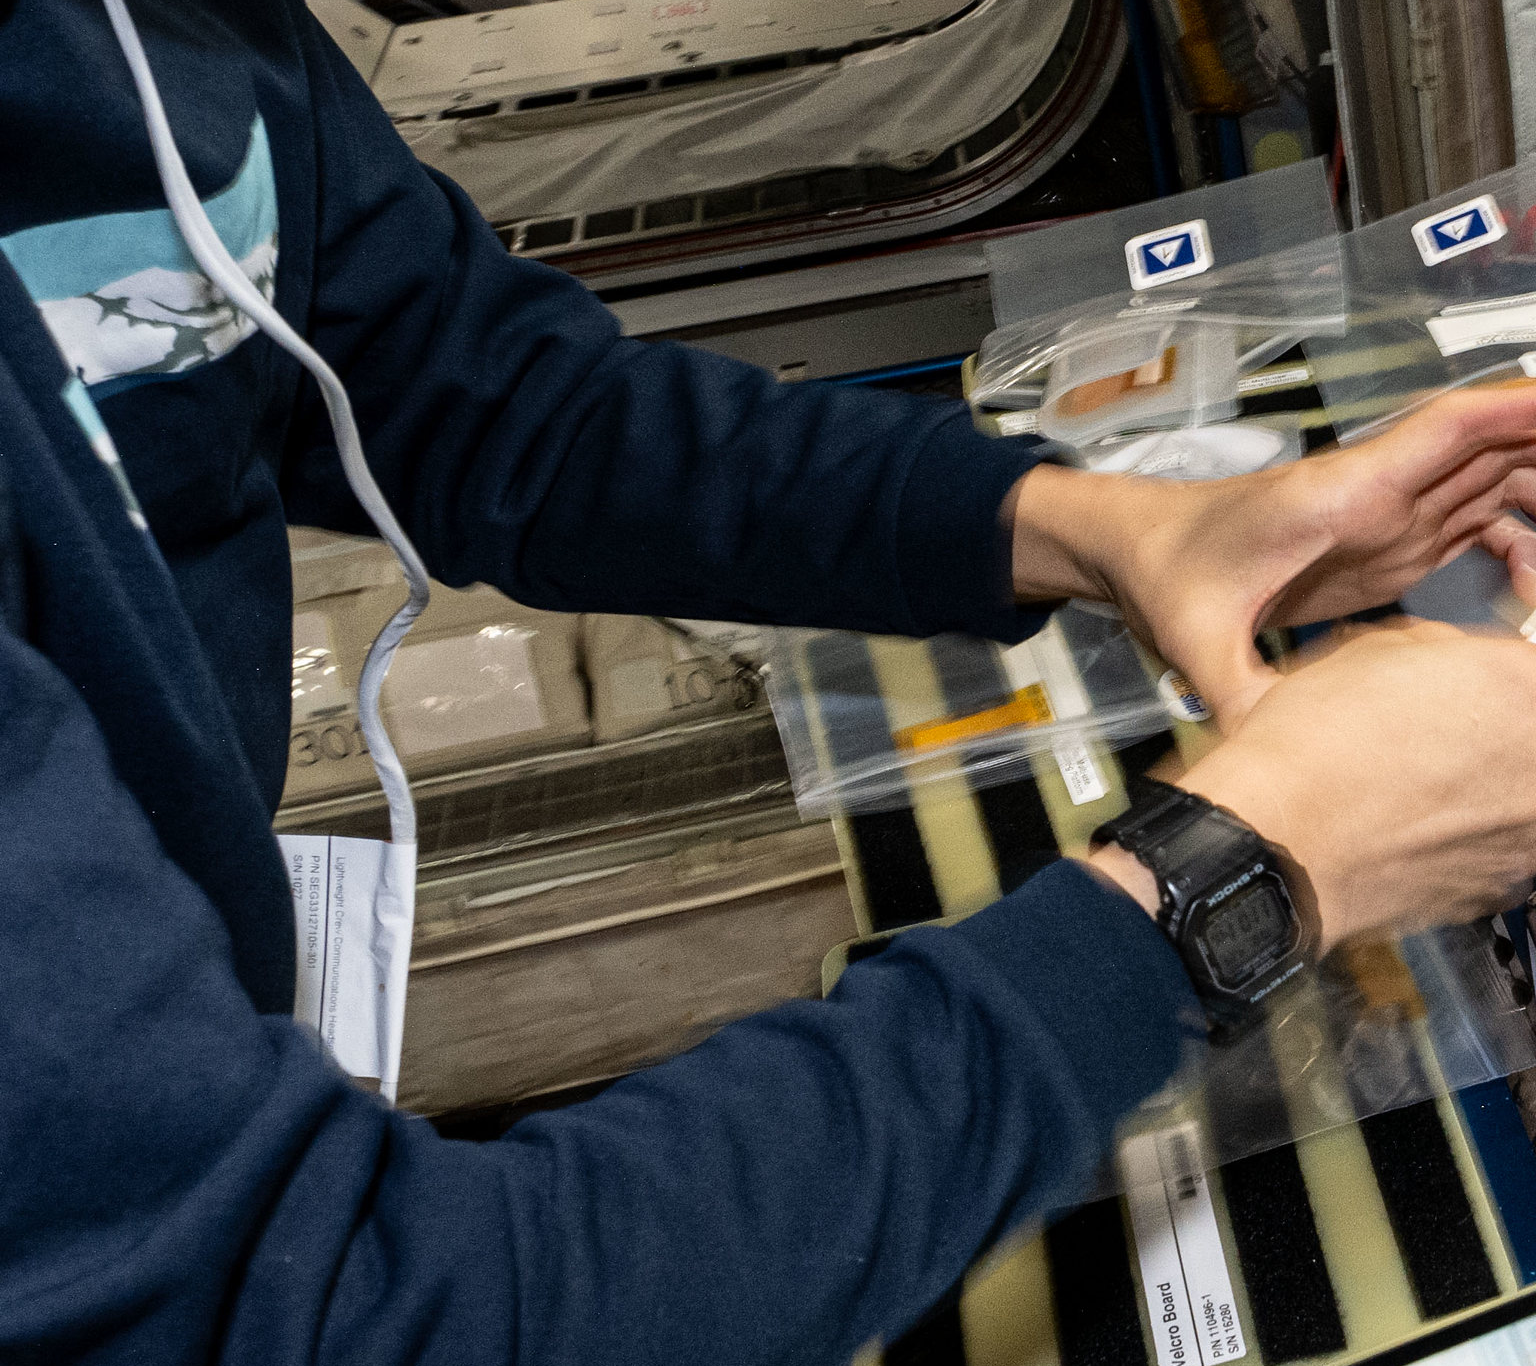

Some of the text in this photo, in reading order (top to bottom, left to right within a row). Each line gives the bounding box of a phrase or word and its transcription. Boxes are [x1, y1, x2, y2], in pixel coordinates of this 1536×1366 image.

[292, 854, 303, 874] S/N
[309, 854, 321, 874] P/N
[334, 856, 347, 913] Lightweight
[328, 935, 344, 1013] Communications
[1156, 1281, 1178, 1323] Board
[1200, 1293, 1225, 1359] P/N 110496-1
[1218, 1303, 1240, 1355] S/N 16280
